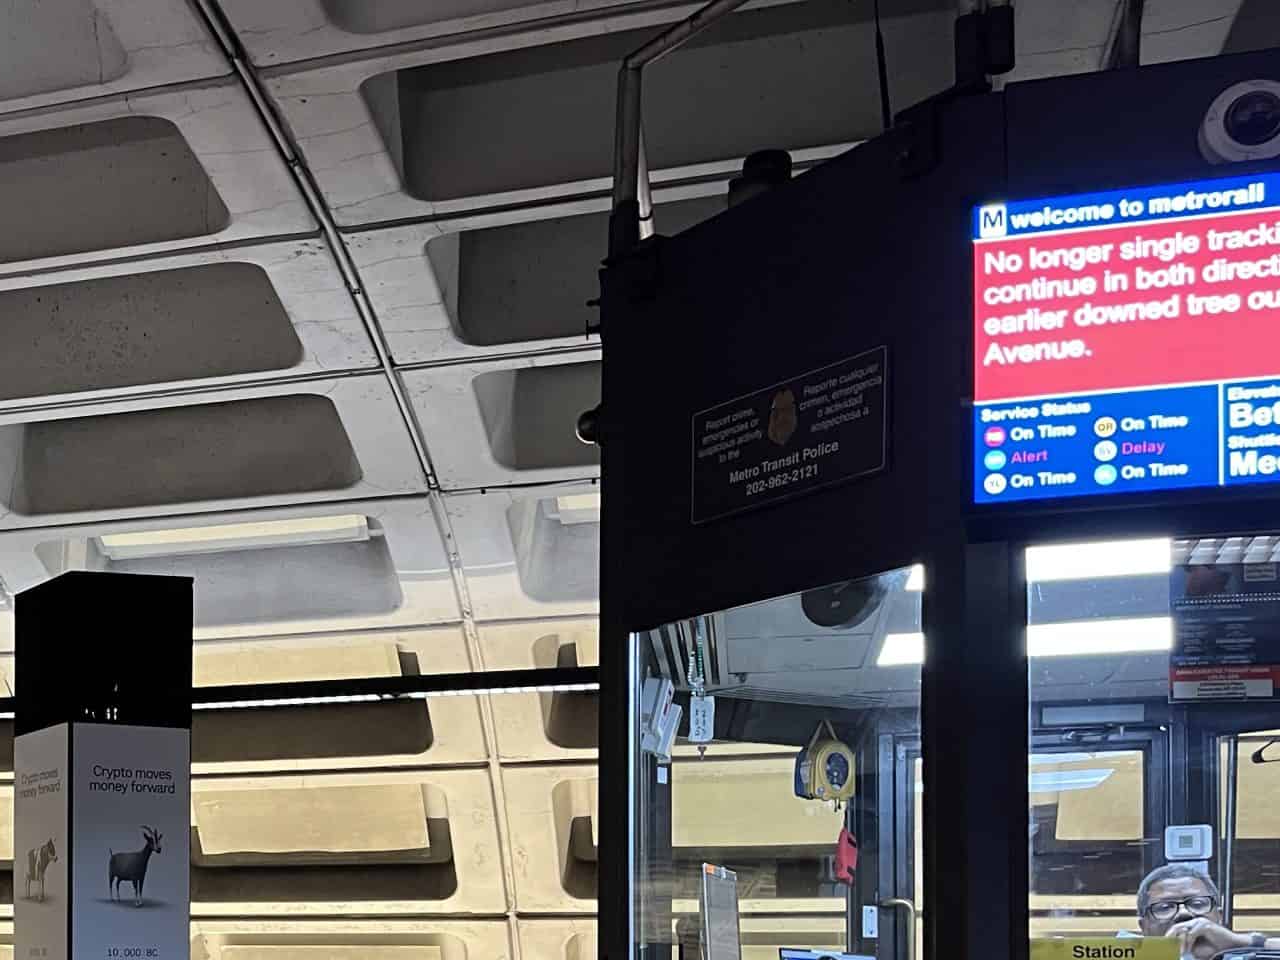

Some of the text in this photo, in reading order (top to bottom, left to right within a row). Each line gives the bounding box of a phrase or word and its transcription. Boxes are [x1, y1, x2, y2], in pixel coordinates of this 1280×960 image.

[983, 182, 1265, 229] M welcome to metrorail
[984, 251, 1022, 275] No
[1029, 244, 1113, 272] longer
[1120, 232, 1199, 262] single
[984, 276, 1096, 305] continue
[1104, 270, 1128, 291] in
[1136, 262, 1195, 290] both
[984, 307, 1067, 335] earlier
[1074, 294, 1179, 327] downed
[1187, 292, 1240, 316] tree
[983, 339, 1092, 366] Avenue.
[981, 402, 1091, 422] Service Status
[1121, 417, 1145, 431] On
[1148, 415, 1188, 429] Time
[1010, 427, 1034, 441] On
[1037, 424, 1077, 439] Time
[1011, 450, 1048, 464] Alert
[1121, 441, 1166, 456] Delay
[729, 440, 839, 483] Metro Transit Police
[1230, 449, 1280, 476] Me
[746, 463, 819, 496] 202-962-2121
[1010, 475, 1034, 488] On
[1037, 472, 1077, 485] Time
[1121, 465, 1145, 480] On
[1148, 463, 1188, 477] Time
[93, 765, 171, 782] Crypto moves
[89, 780, 175, 795] money forward
[1073, 945, 1135, 959] Station
